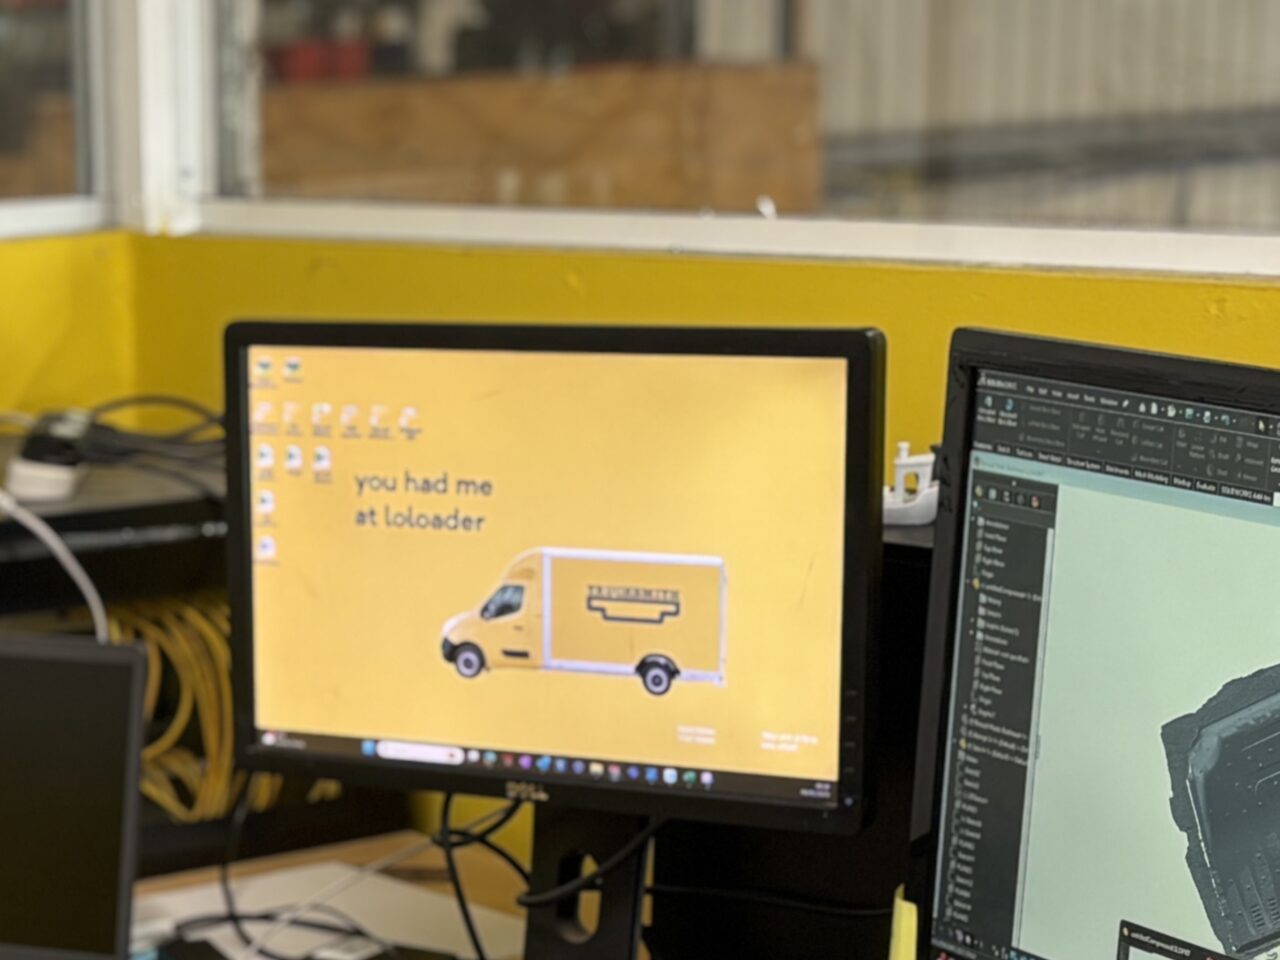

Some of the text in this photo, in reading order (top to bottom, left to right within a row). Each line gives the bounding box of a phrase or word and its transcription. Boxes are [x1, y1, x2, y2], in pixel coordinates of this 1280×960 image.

[353, 472, 396, 498] you
[404, 470, 447, 495] had
[455, 479, 494, 497] me
[354, 506, 486, 532] at loloader
